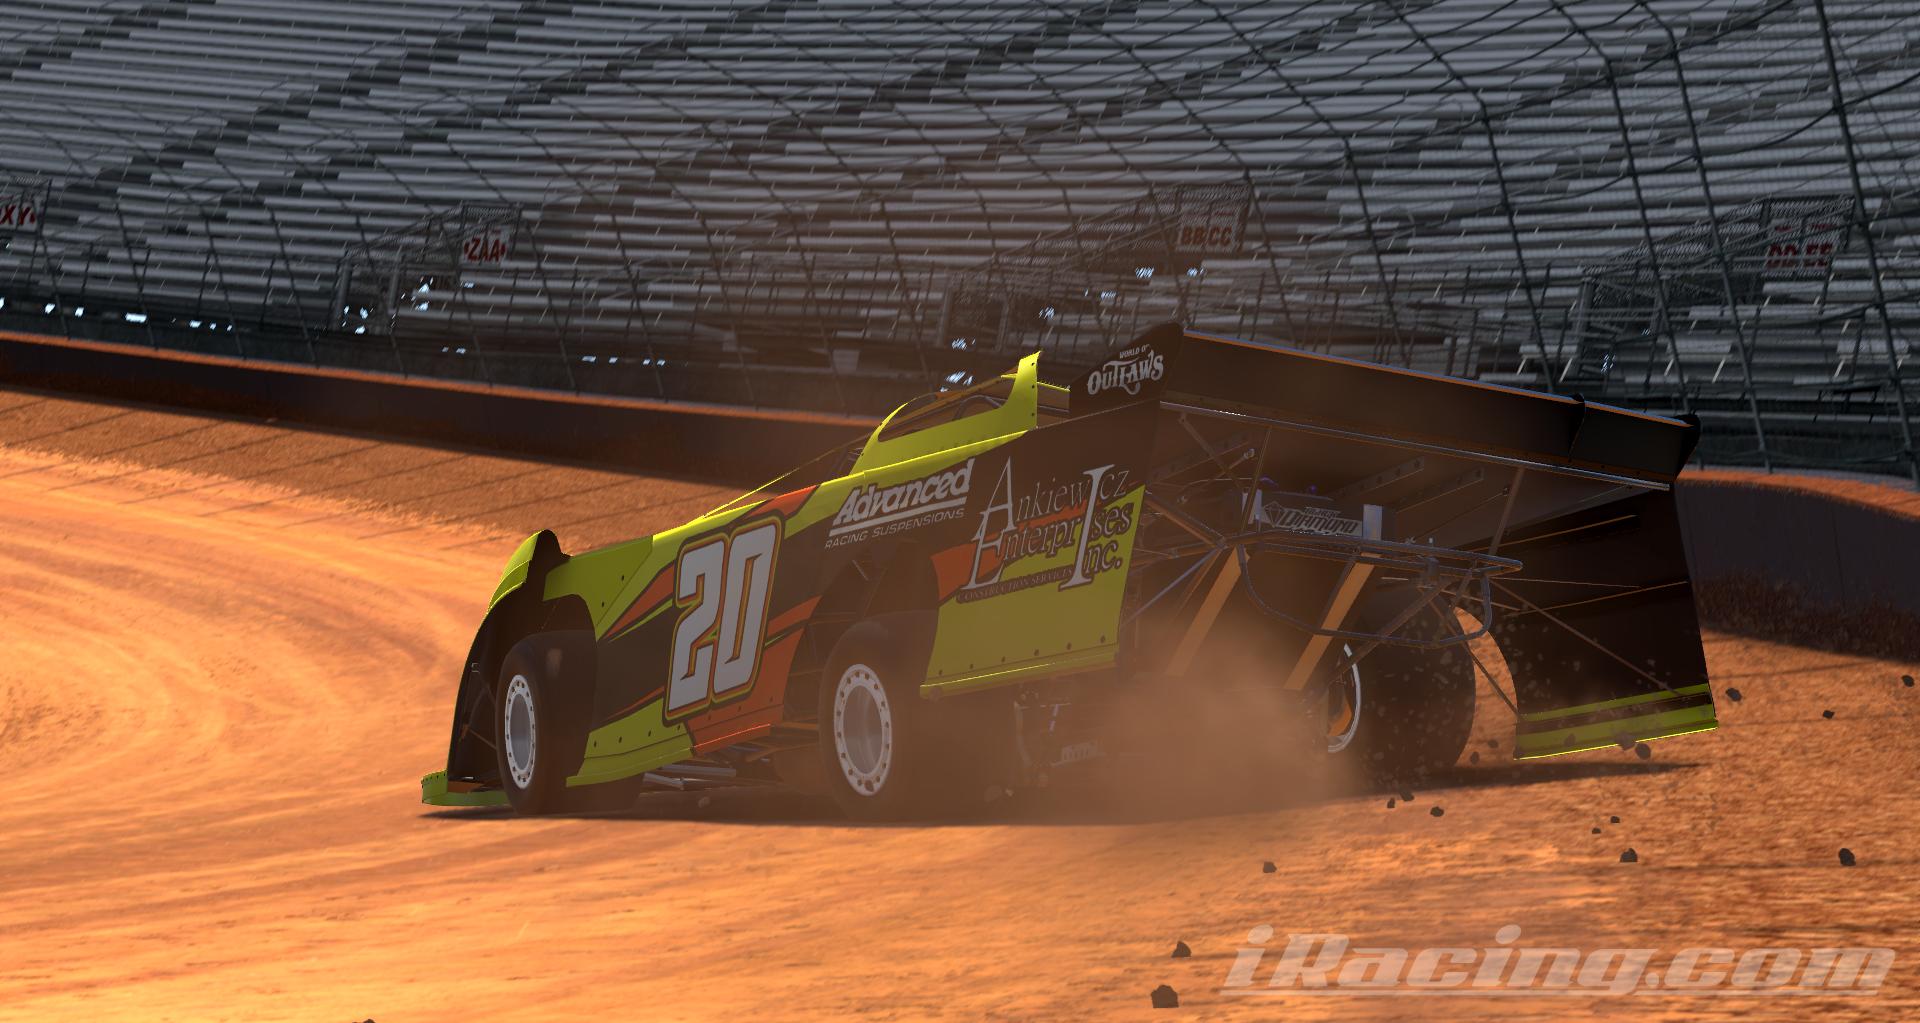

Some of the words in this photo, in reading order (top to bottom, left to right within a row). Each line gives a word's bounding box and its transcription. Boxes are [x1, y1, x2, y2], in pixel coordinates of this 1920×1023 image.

[1119, 347, 1140, 359] WORLD
[832, 458, 976, 526] Advanced
[824, 530, 869, 549] RACING
[871, 508, 966, 538] SUSPENSIONS
[1031, 567, 1074, 585] SERVICES
[666, 520, 780, 715] 20
